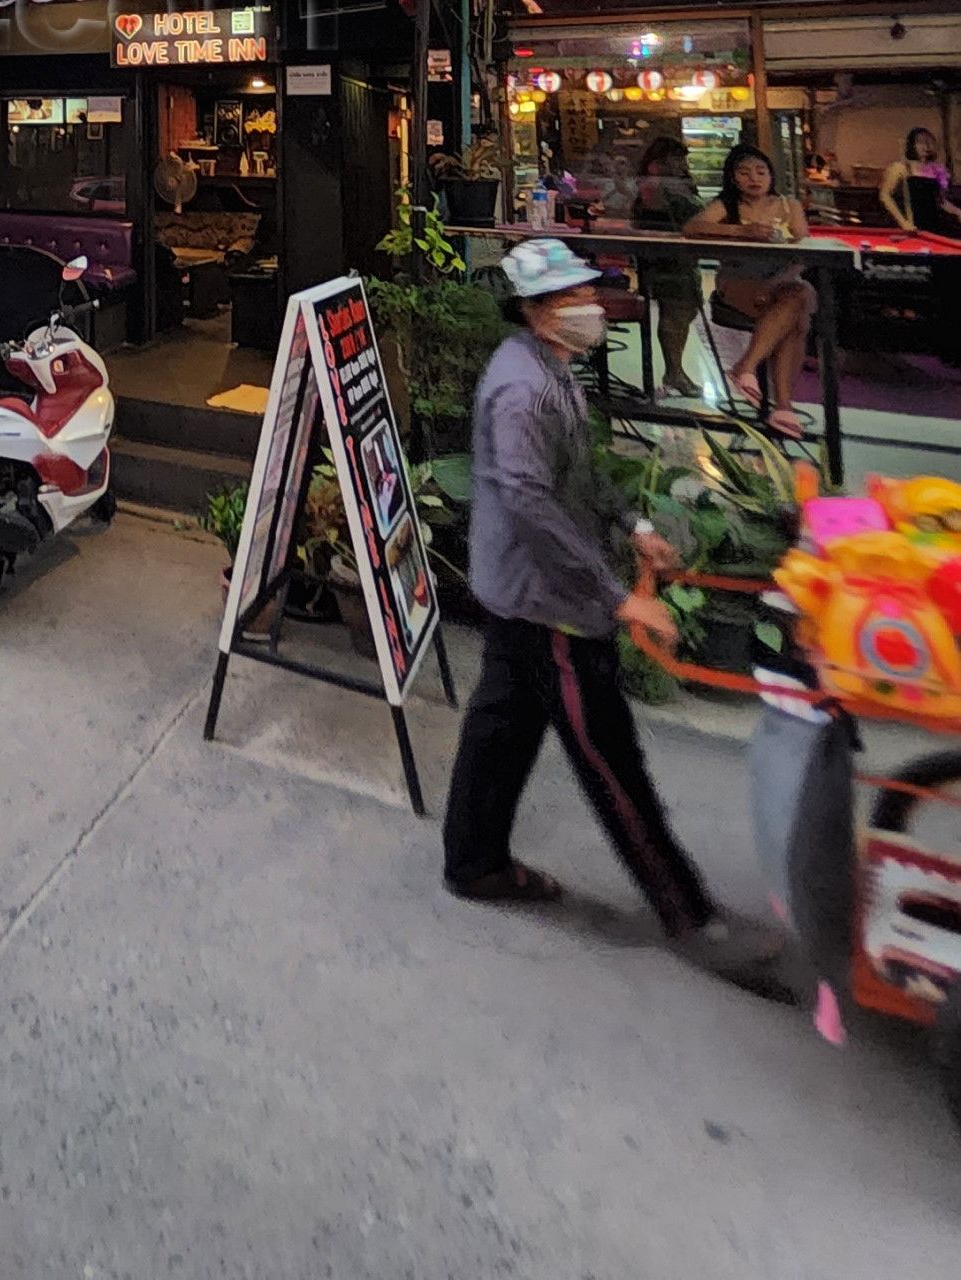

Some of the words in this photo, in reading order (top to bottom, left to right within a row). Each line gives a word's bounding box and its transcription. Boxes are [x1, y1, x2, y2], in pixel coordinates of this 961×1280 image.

[154, 11, 221, 36] HOTEL
[116, 41, 170, 65] LOVE
[174, 38, 223, 62] TIME
[228, 36, 267, 61] INN
